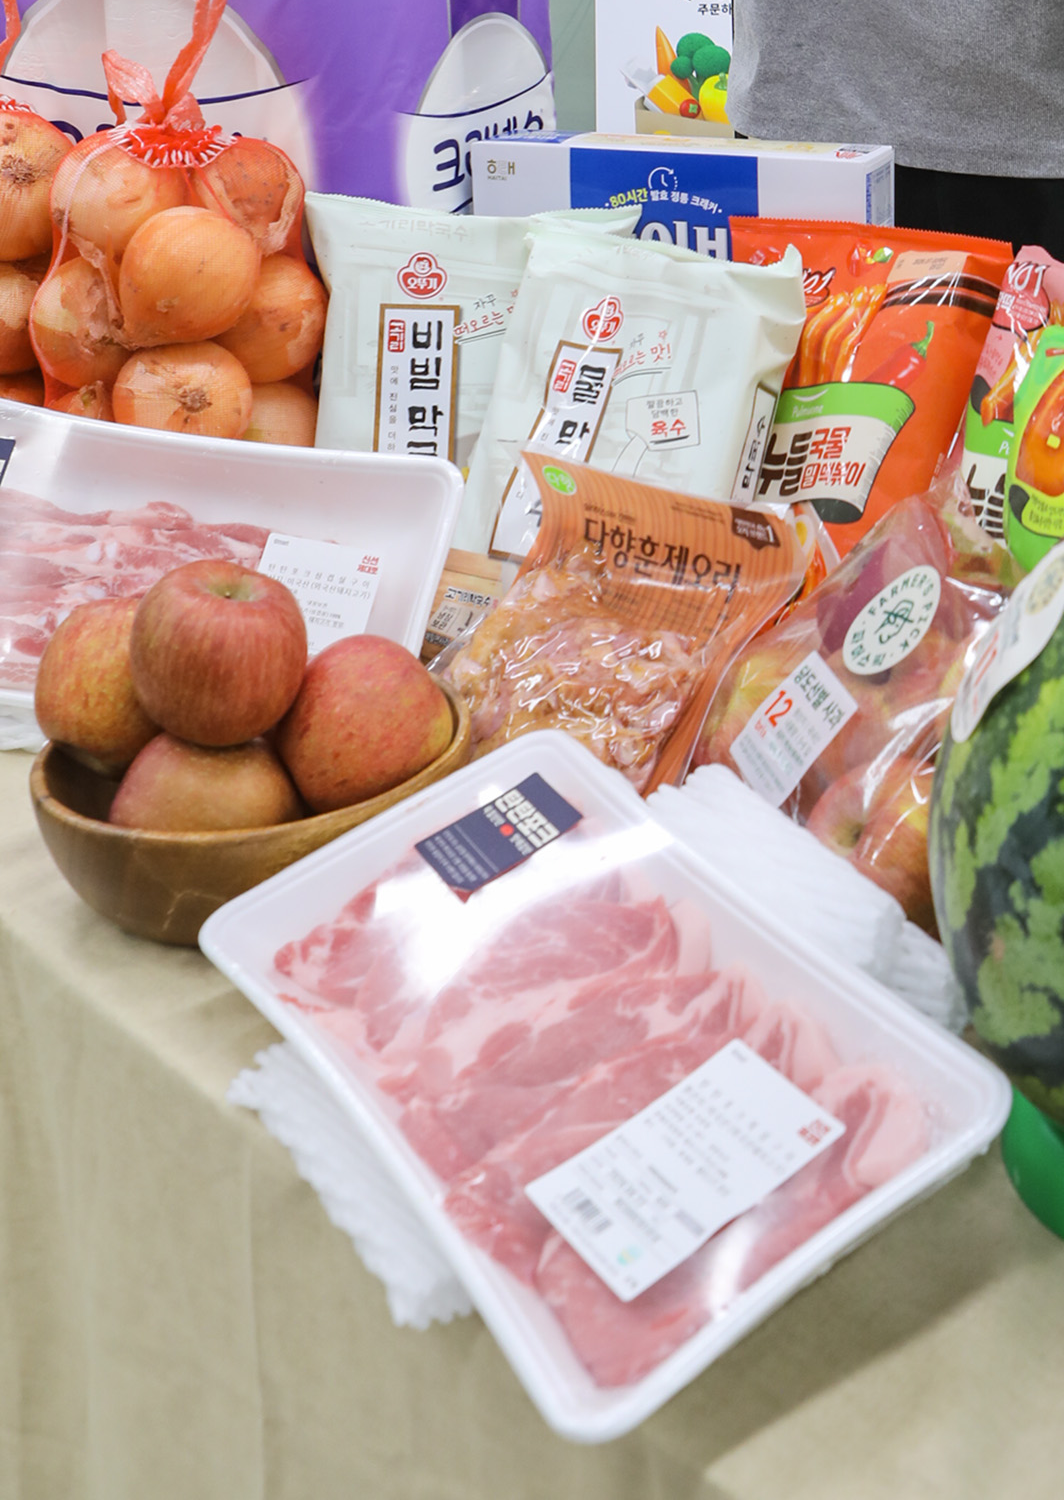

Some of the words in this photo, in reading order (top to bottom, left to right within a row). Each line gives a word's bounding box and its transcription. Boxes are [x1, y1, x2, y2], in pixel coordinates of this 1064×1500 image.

[609, 187, 648, 208] 80시간
[406, 276, 438, 291] 오뚜기
[474, 294, 498, 311] 자꾸
[454, 310, 505, 337] 떠오르는
[650, 342, 673, 366] 맛!
[650, 418, 687, 438] 육수
[809, 426, 852, 460] 국물
[361, 554, 380, 566] 신선
[584, 517, 742, 595] 다향훈제오리
[764, 689, 794, 729] 12
[794, 665, 831, 711] 당도선별
[822, 701, 845, 731] 사과
[494, 788, 561, 849] 탄탄포크
